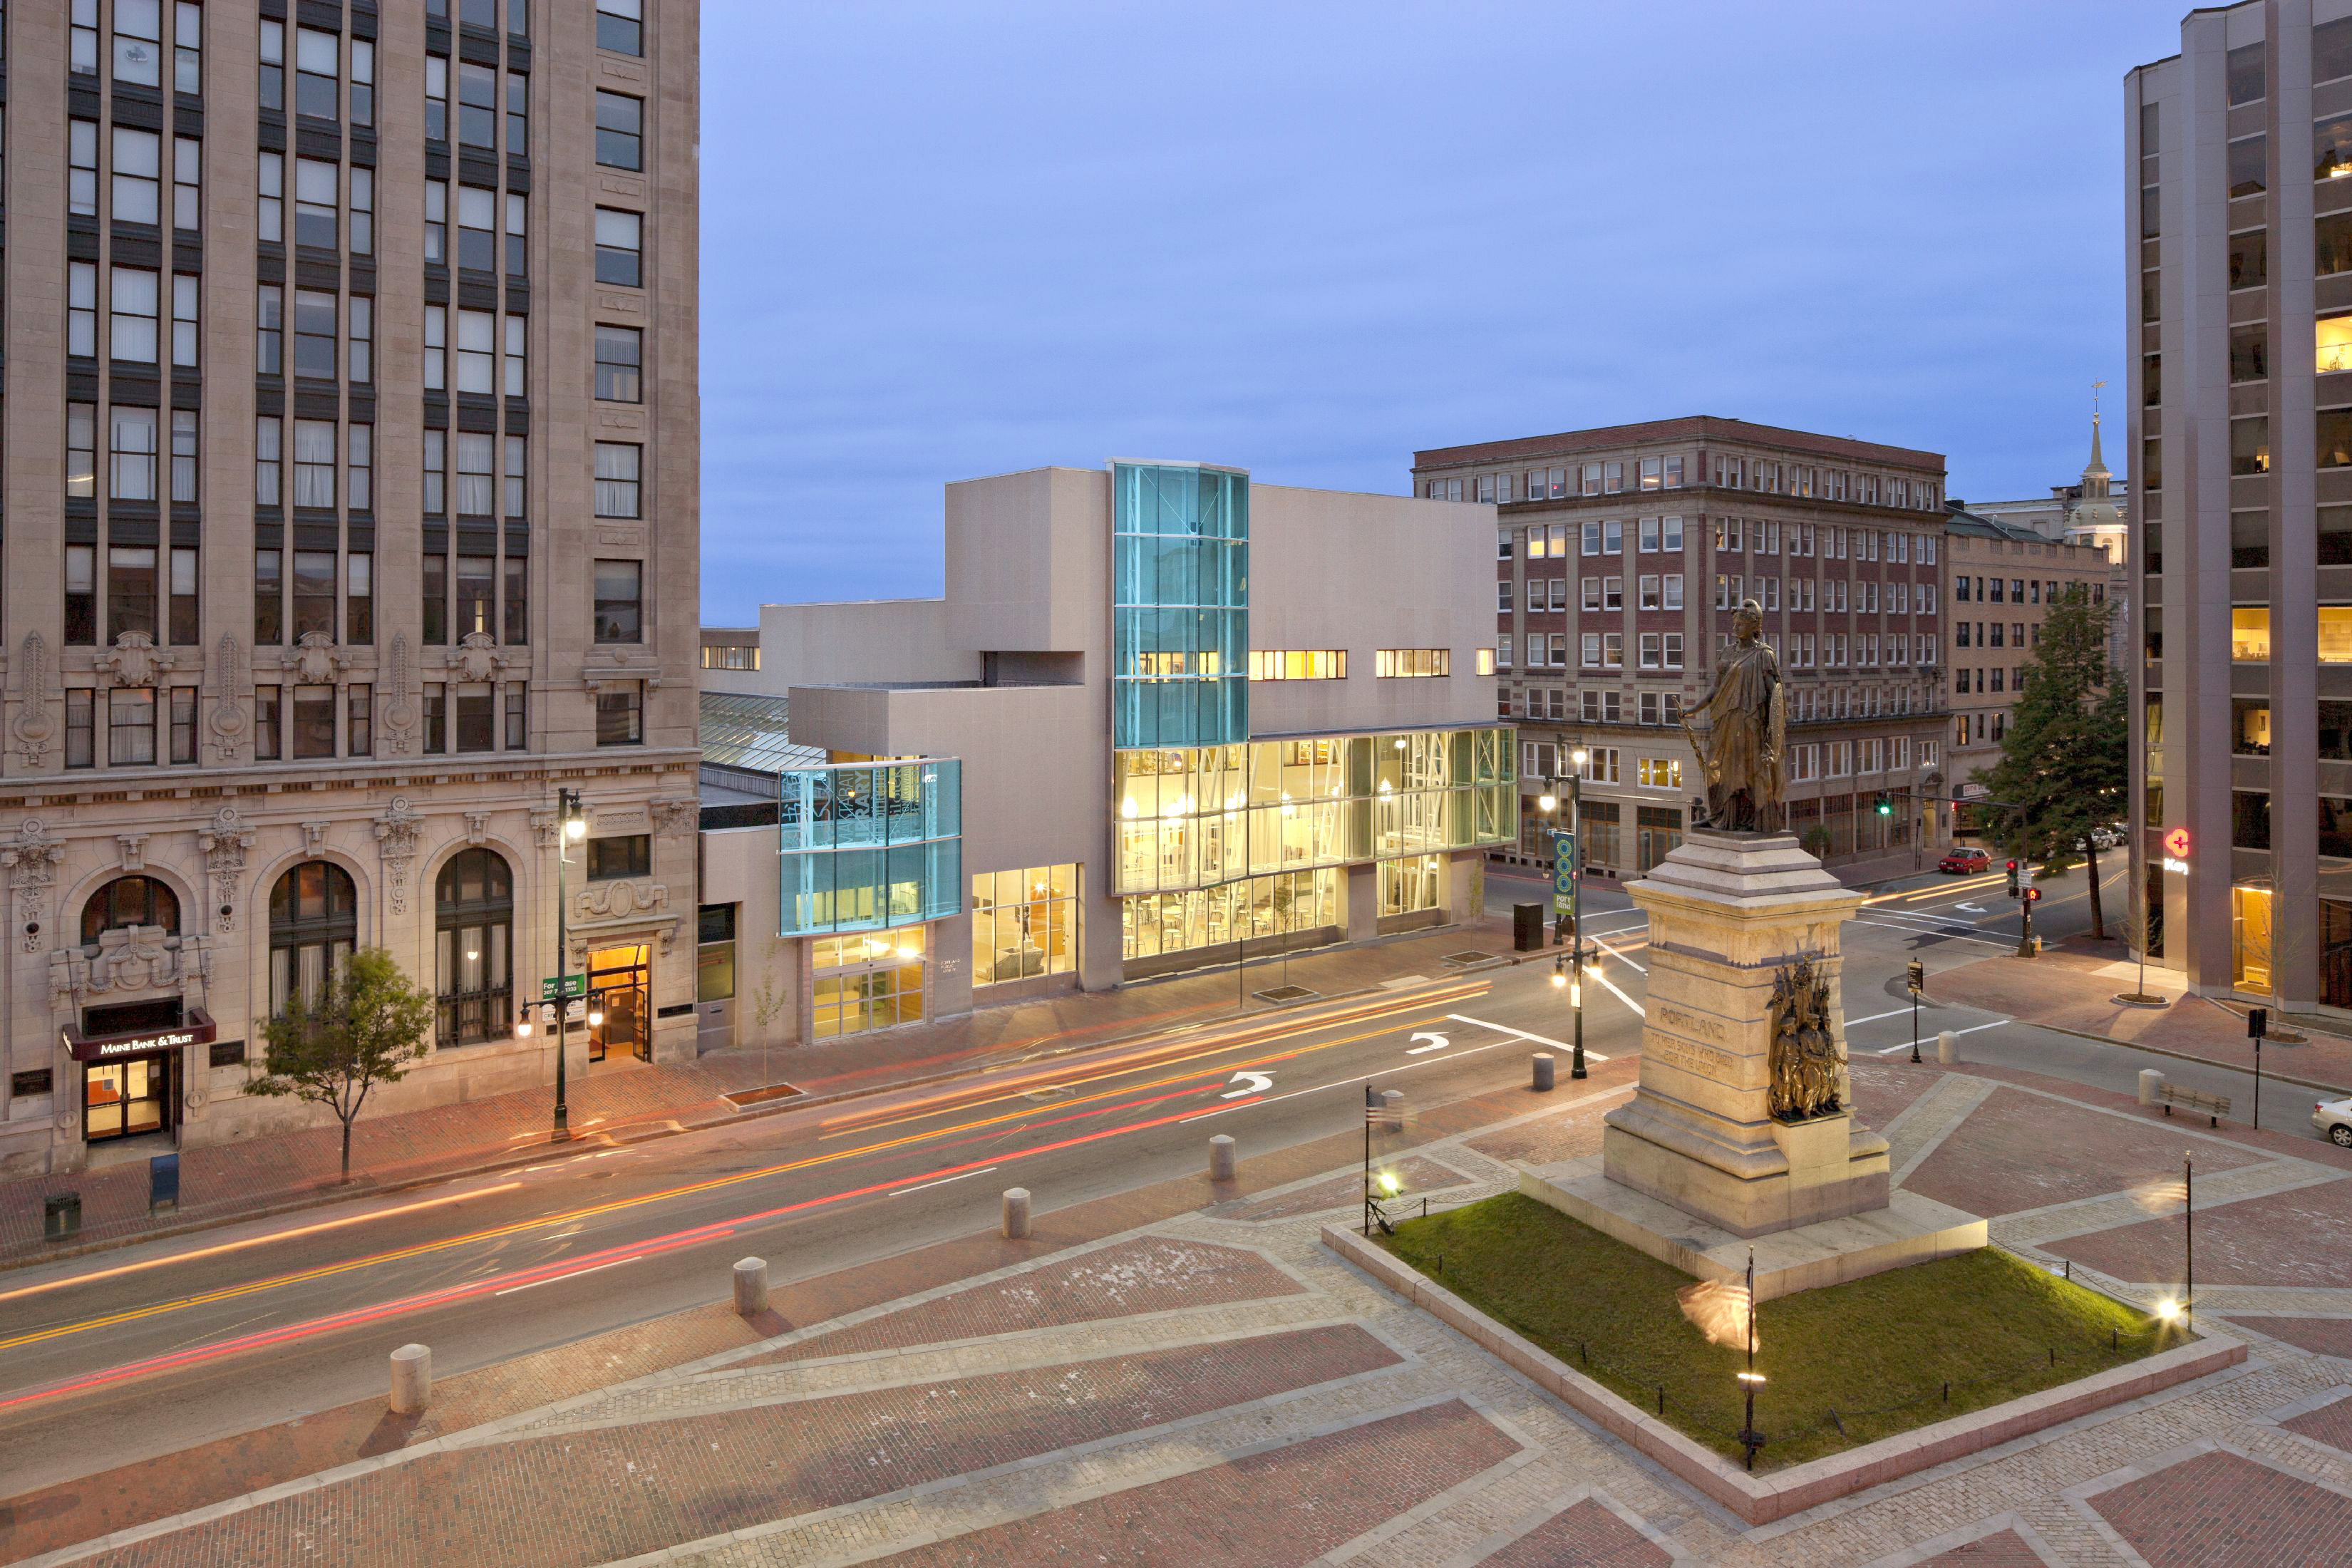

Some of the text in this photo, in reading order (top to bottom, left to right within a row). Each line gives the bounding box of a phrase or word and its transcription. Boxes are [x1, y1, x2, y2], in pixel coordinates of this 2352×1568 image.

[1660, 1007, 1725, 1041] PORTLAND
[100, 1034, 194, 1055] MAINE BANK & TRUST
[1651, 1033, 1733, 1070] TO HER SONS WHO DIED
[1665, 1050, 1717, 1075] FOR THE UNION
